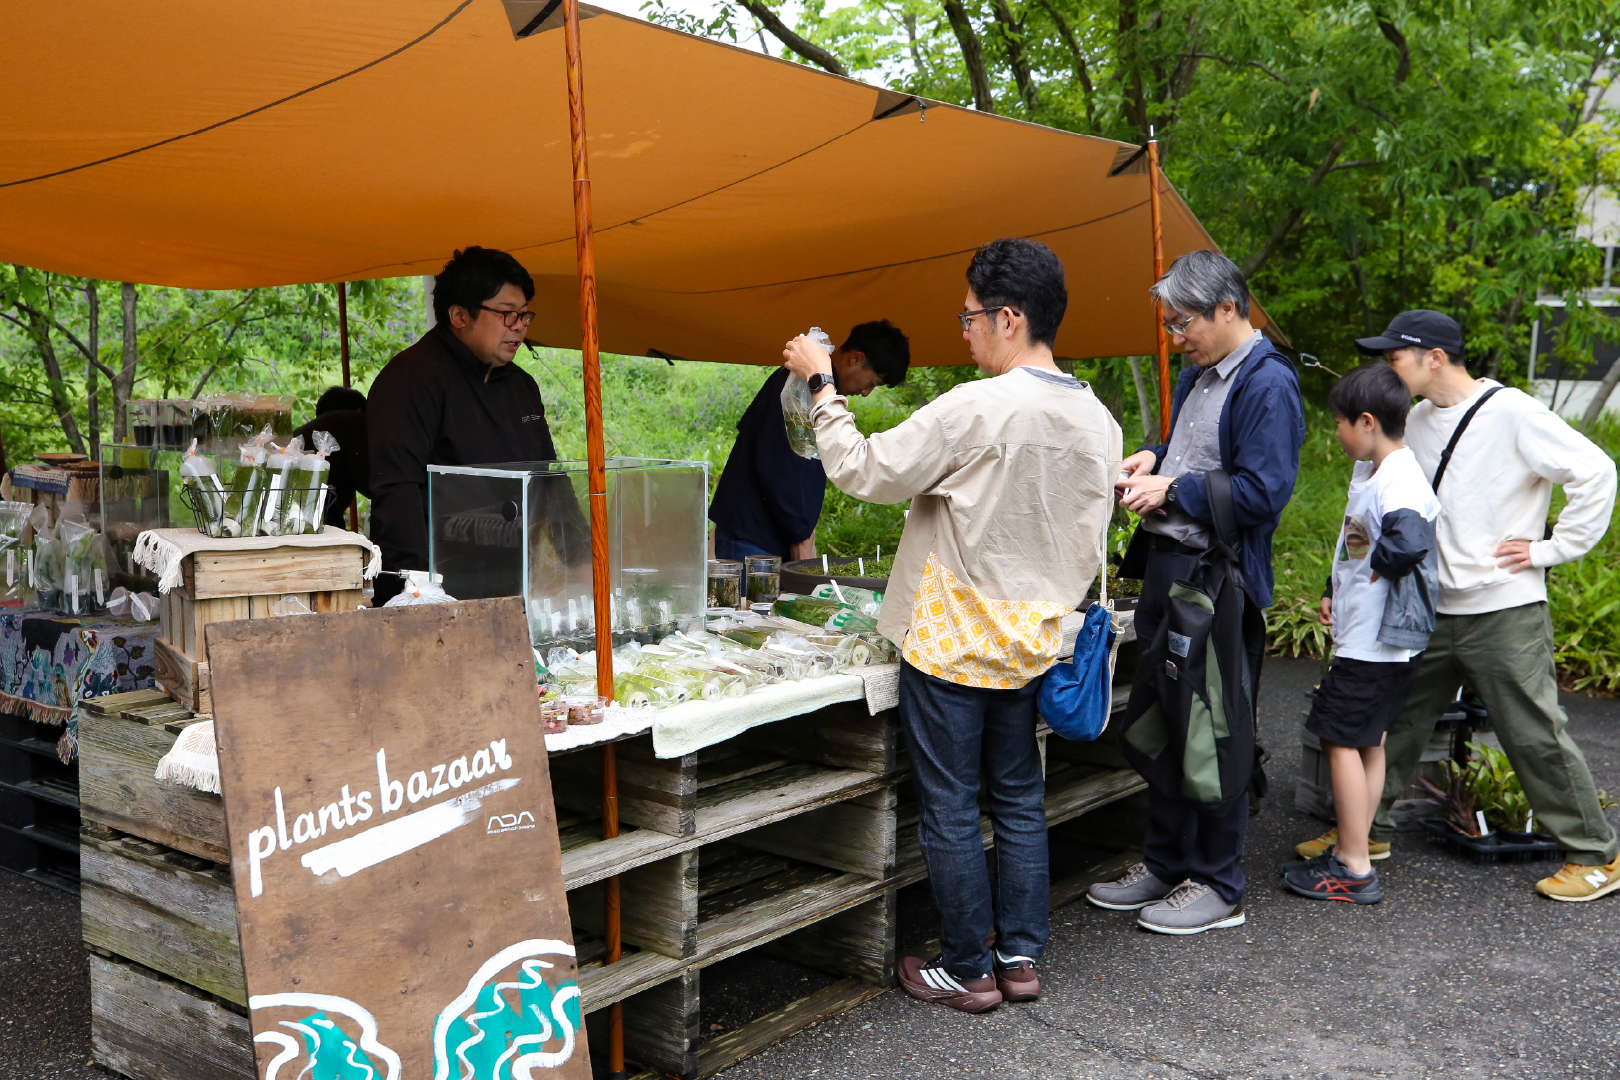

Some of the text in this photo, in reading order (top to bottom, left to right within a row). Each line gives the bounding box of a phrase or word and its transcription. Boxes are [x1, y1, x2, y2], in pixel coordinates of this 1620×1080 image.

[248, 738, 512, 898] plants bazaar
[1584, 869, 1608, 889] N
